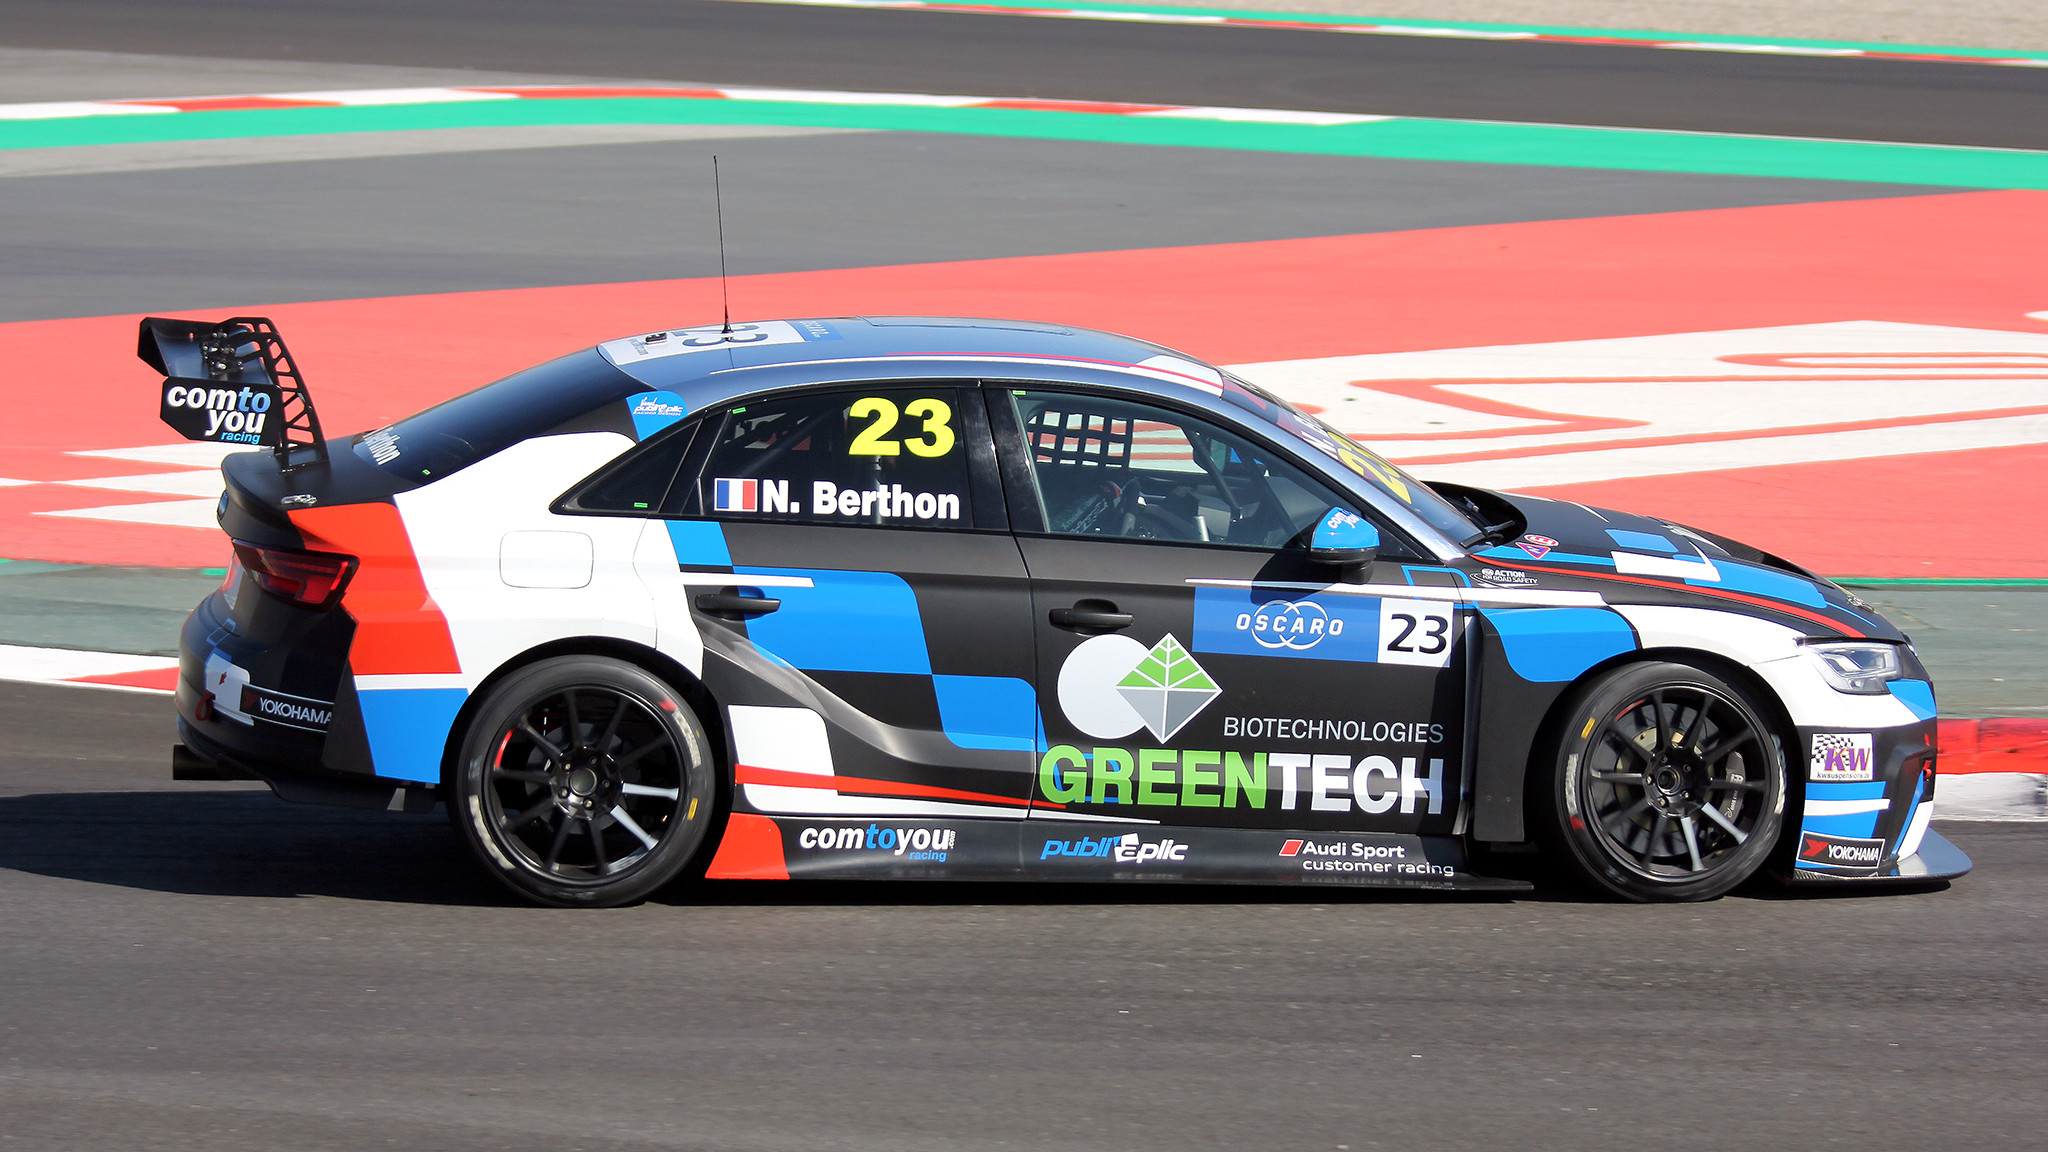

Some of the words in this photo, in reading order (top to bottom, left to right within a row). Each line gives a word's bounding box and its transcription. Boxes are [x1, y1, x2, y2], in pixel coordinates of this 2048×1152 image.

[205, 408, 266, 437] you
[849, 397, 955, 457] 23
[221, 431, 261, 445] racing
[762, 479, 800, 513] N.
[813, 480, 960, 520] Berthon
[1494, 569, 1526, 578] ACTION
[1512, 576, 1539, 584] SAFETY
[1235, 613, 1344, 636] OSCARO
[1387, 613, 1449, 654] 23
[1223, 717, 1444, 744] BIOTECHNOLOGIES
[1823, 747, 1871, 772] KW
[1039, 744, 1443, 815] GREENTECH
[909, 849, 947, 863] racing
[1302, 841, 1347, 857] Audi
[1351, 842, 1405, 860] Sport
[1828, 844, 1879, 861] YOKOHAMA
[1302, 858, 1392, 873] customer
[1397, 861, 1455, 877] racing
